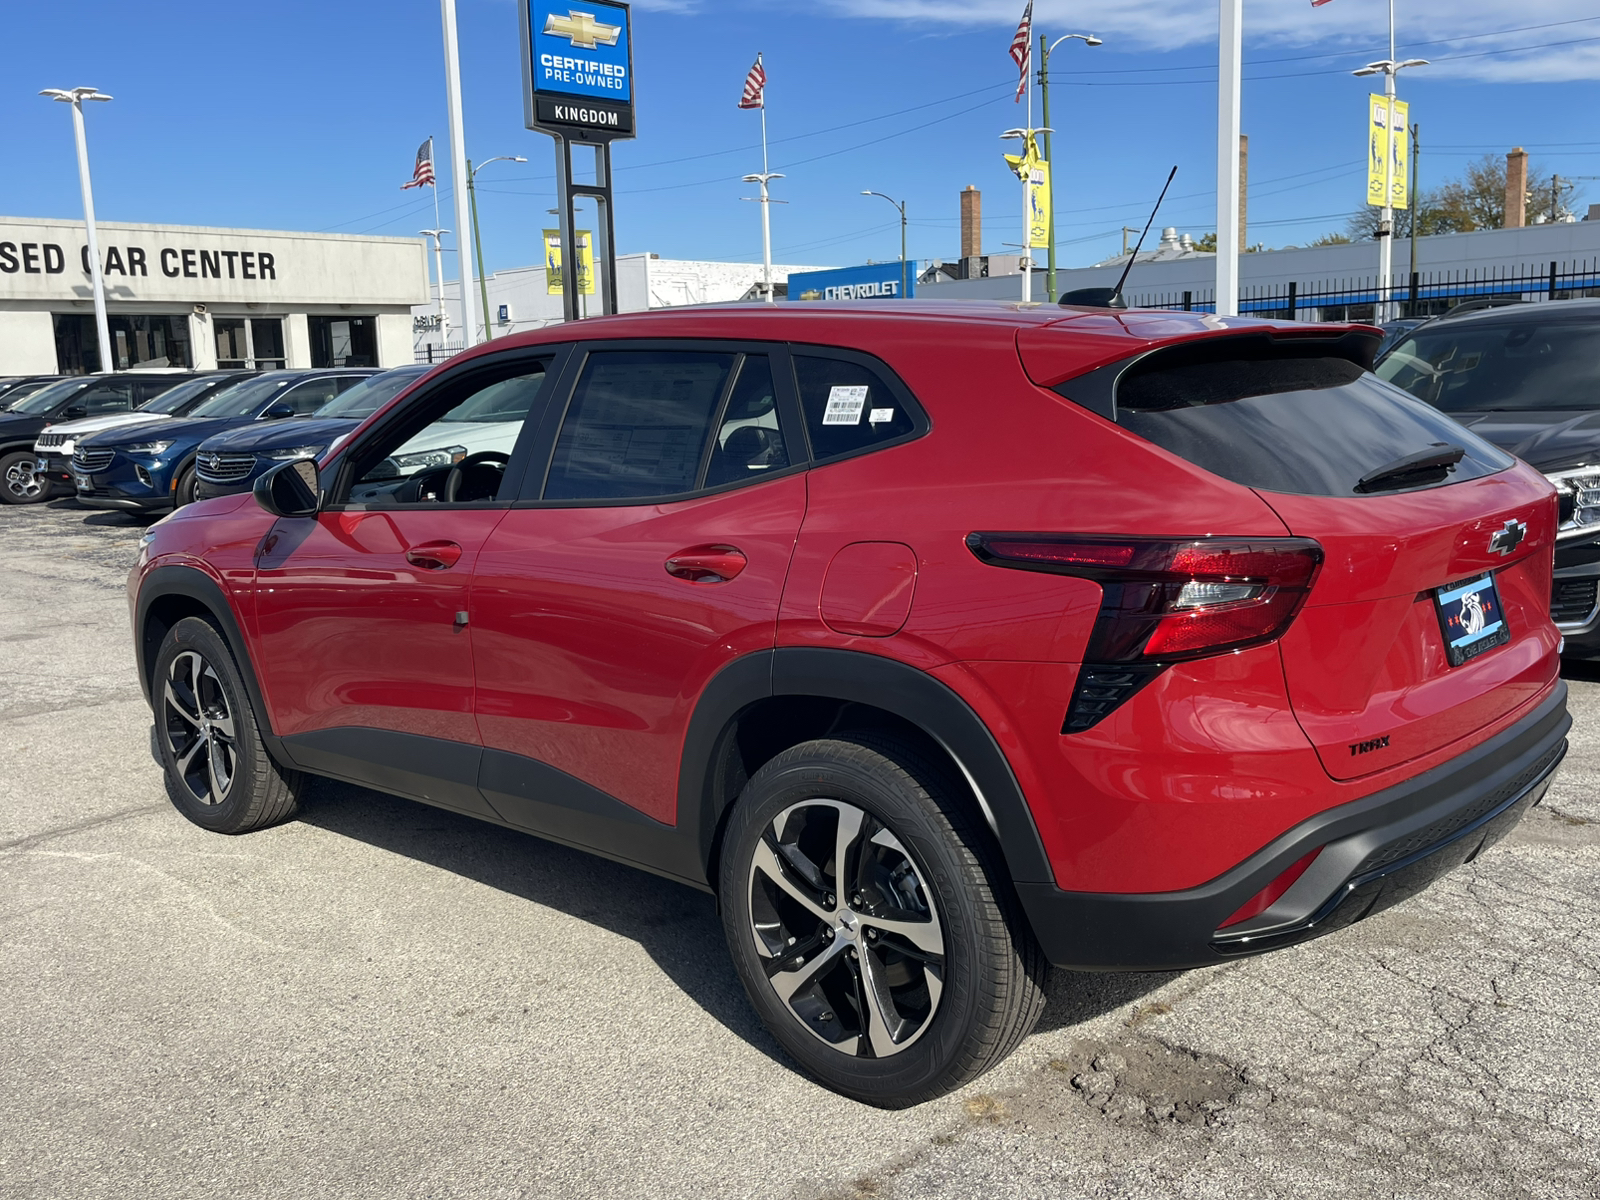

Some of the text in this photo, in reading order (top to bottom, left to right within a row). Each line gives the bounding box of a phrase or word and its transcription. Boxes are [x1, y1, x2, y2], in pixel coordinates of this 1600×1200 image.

[541, 54, 625, 77] CERTIFIED
[545, 68, 622, 89] PRE-OWNED
[555, 105, 618, 125] KINGDOM
[160, 248, 276, 280] CENTER
[825, 280, 899, 301] CHEVROLET
[1348, 735, 1390, 757] TRAX
[933, 866, 969, 1019] GOODYEAR
